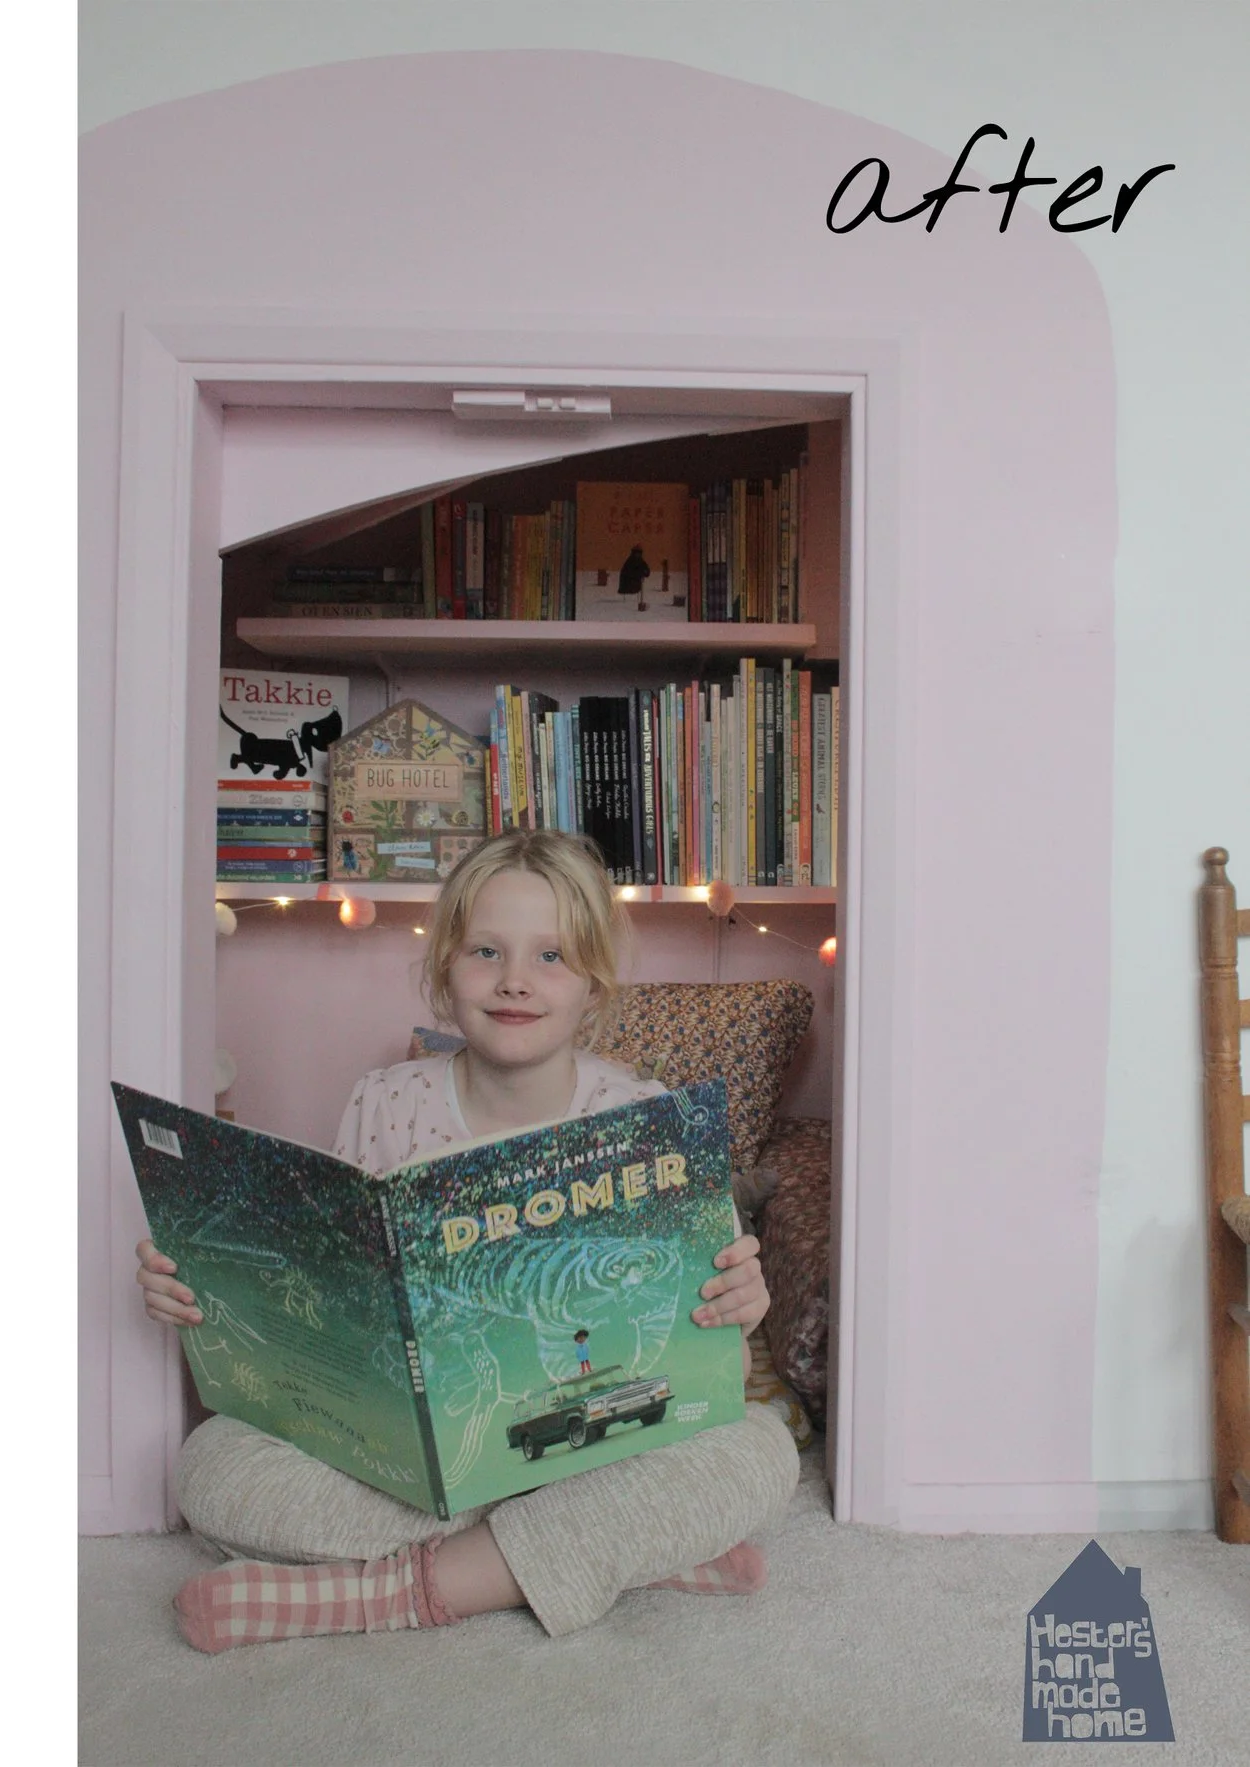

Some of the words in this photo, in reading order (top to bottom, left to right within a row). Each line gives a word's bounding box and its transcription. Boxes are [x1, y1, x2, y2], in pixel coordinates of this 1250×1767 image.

[223, 676, 332, 706] Takkie
[367, 769, 395, 789] BUG
[402, 769, 451, 789] HOTEL
[497, 1164, 548, 1189] MARK
[554, 1141, 628, 1176] JANSSEN
[442, 1153, 690, 1254] DROMER
[405, 1340, 425, 1393] DROMER
